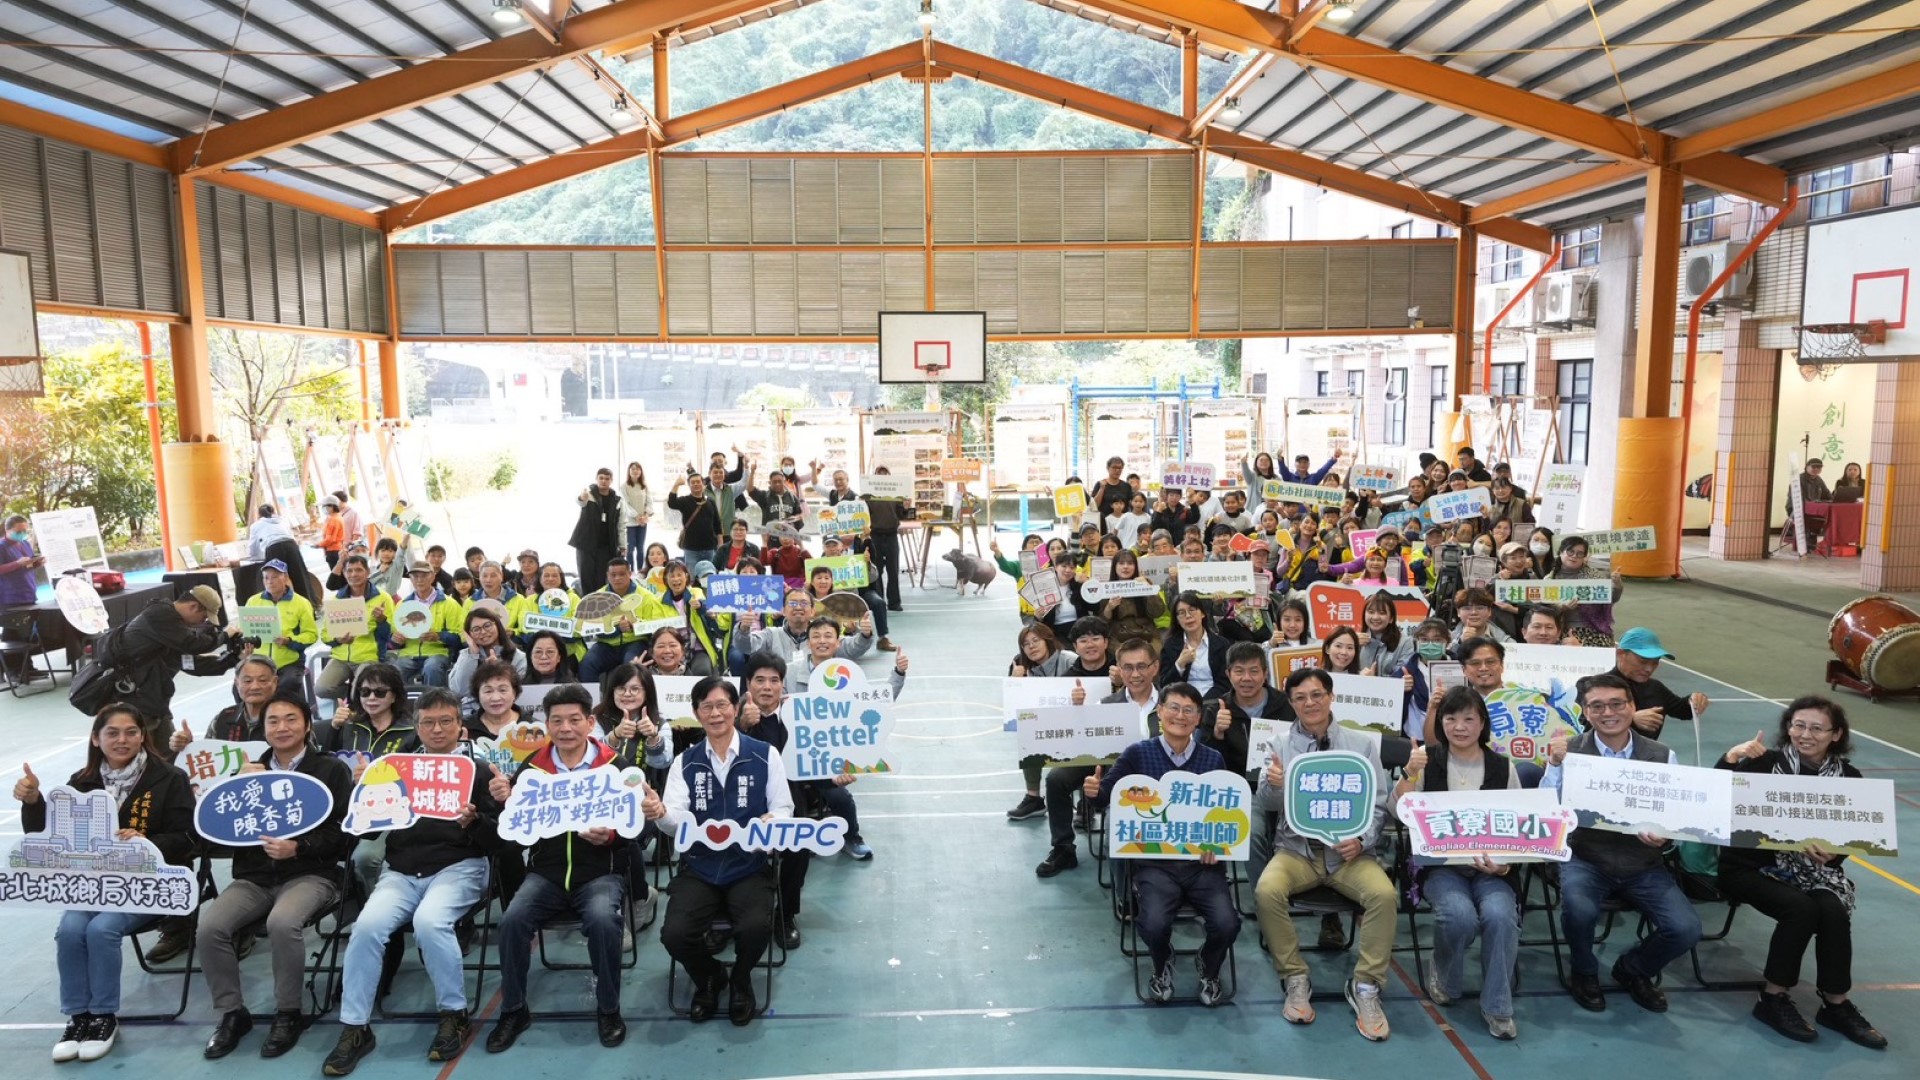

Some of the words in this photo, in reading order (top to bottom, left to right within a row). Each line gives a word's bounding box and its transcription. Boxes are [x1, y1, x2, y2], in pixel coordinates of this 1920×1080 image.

[1820, 402, 1846, 461] 創意
[1059, 491, 1081, 509] 福
[710, 578, 739, 596] 翻轉
[1508, 585, 1609, 601] 社區環境營造
[734, 593, 766, 606] 新北市
[1327, 597, 1354, 616] 福
[1290, 656, 1317, 671] 新北
[793, 697, 851, 721] New
[1487, 701, 1547, 737] 貢寮
[794, 725, 879, 749] Better
[184, 744, 244, 780] 培力
[412, 758, 461, 783] 新北
[796, 747, 845, 777] Life
[516, 774, 621, 806] 社區好人
[1170, 781, 1241, 809] 新北市
[1299, 773, 1363, 794] 城鄉局
[215, 778, 260, 814] 我愛
[412, 787, 461, 814] 城鄉
[1624, 796, 1665, 812] 第二期
[234, 799, 304, 837] 陳香菊
[1425, 808, 1552, 840] 貢寮國小
[1735, 804, 1885, 823] 金美國小接送區環境改善
[680, 822, 687, 845] I
[748, 823, 838, 846] NTPC
[1116, 820, 1239, 844] 社區規劃師
[1420, 842, 1465, 852] Gongliao
[1468, 841, 1528, 854] Elementary
[1532, 845, 1567, 857] School
